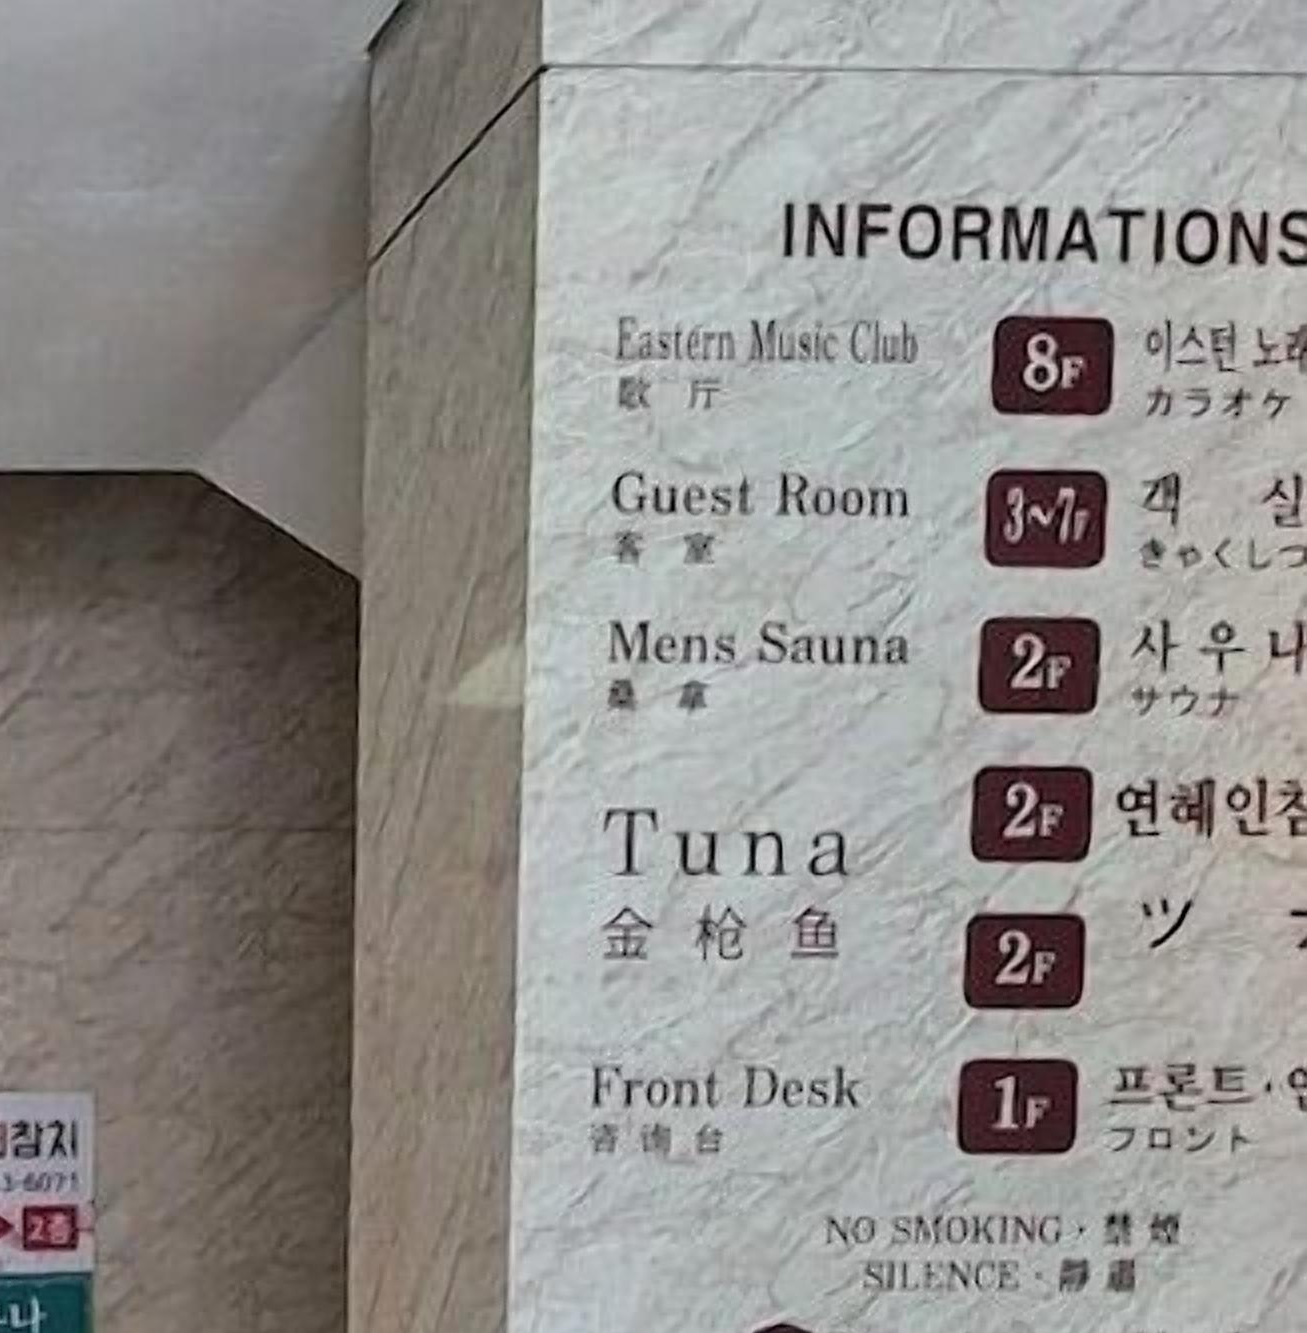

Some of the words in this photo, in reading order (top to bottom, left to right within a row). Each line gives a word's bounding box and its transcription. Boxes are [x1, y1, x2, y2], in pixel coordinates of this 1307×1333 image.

[782, 202, 1307, 267] INFORMATIONS
[615, 315, 736, 362] Eastern
[747, 318, 839, 363] Music
[849, 318, 919, 364] Club
[1023, 331, 1085, 393] 8F
[1146, 315, 1244, 374] 이스턴
[1146, 384, 1292, 420] カラオケ
[611, 470, 755, 516] Guest
[775, 471, 910, 518] Room
[607, 619, 736, 664] Mens
[758, 620, 910, 665] Sauna
[1011, 632, 1072, 690] 2F
[1131, 685, 1240, 717] サウナ
[1002, 782, 1065, 839] 2F
[602, 807, 848, 877] Tuna
[601, 903, 840, 962] 金枪鱼
[994, 929, 1057, 986] 2F
[591, 1065, 721, 1110] Front
[743, 1064, 863, 1109] Desk
[991, 1075, 1052, 1131] 1F
[1105, 1125, 1253, 1153] フロント
[825, 1214, 877, 1245] NO
[889, 1213, 1061, 1246] SMOKING
[862, 1259, 1021, 1292] SILENCE
